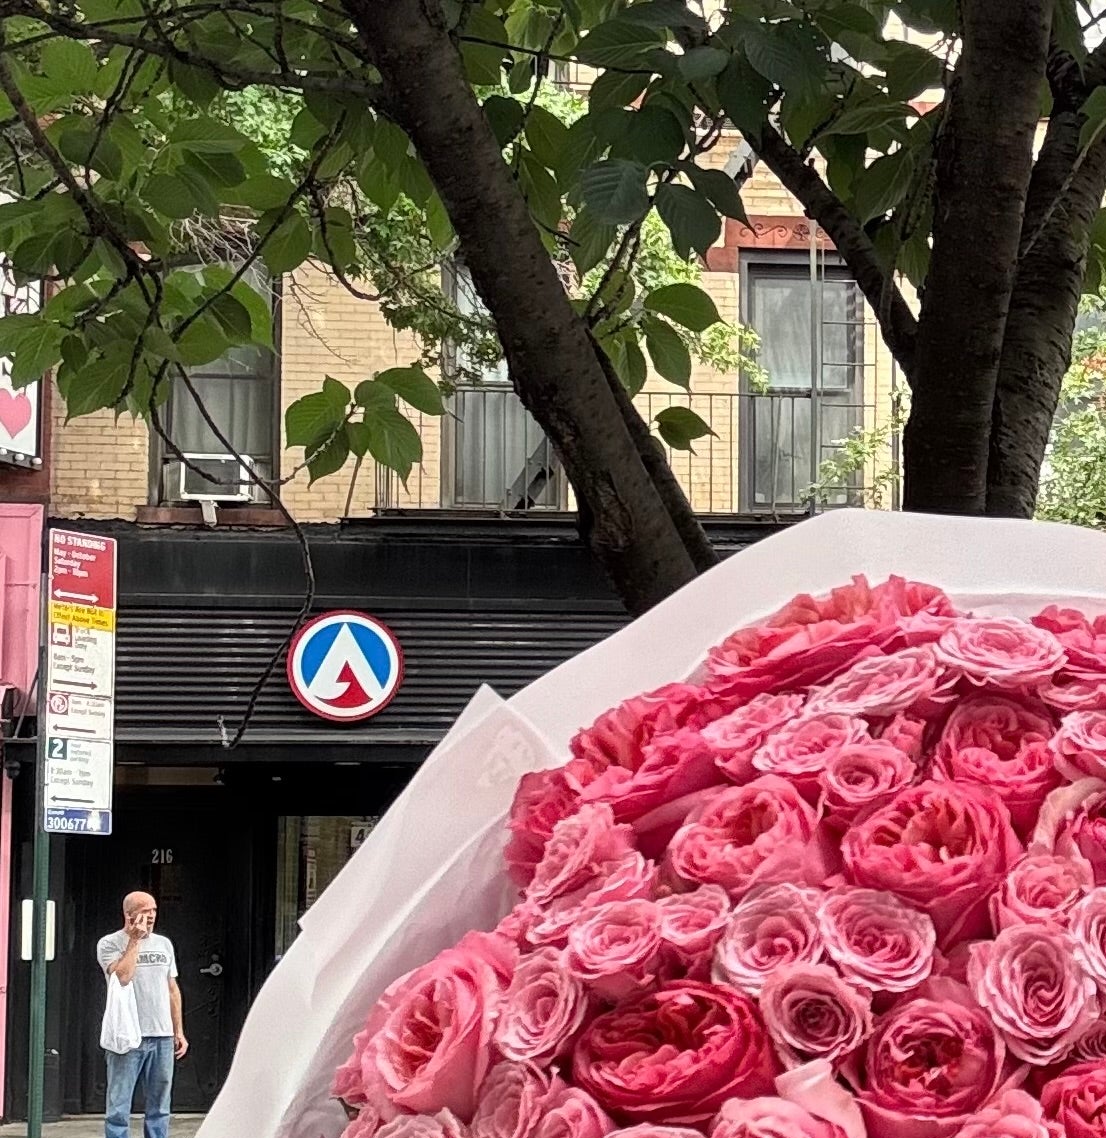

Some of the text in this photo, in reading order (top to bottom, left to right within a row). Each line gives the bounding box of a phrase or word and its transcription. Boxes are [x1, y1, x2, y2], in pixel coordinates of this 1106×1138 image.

[54, 533, 106, 551] NO STANDING
[51, 738, 64, 758] 2
[152, 848, 173, 864] 216
